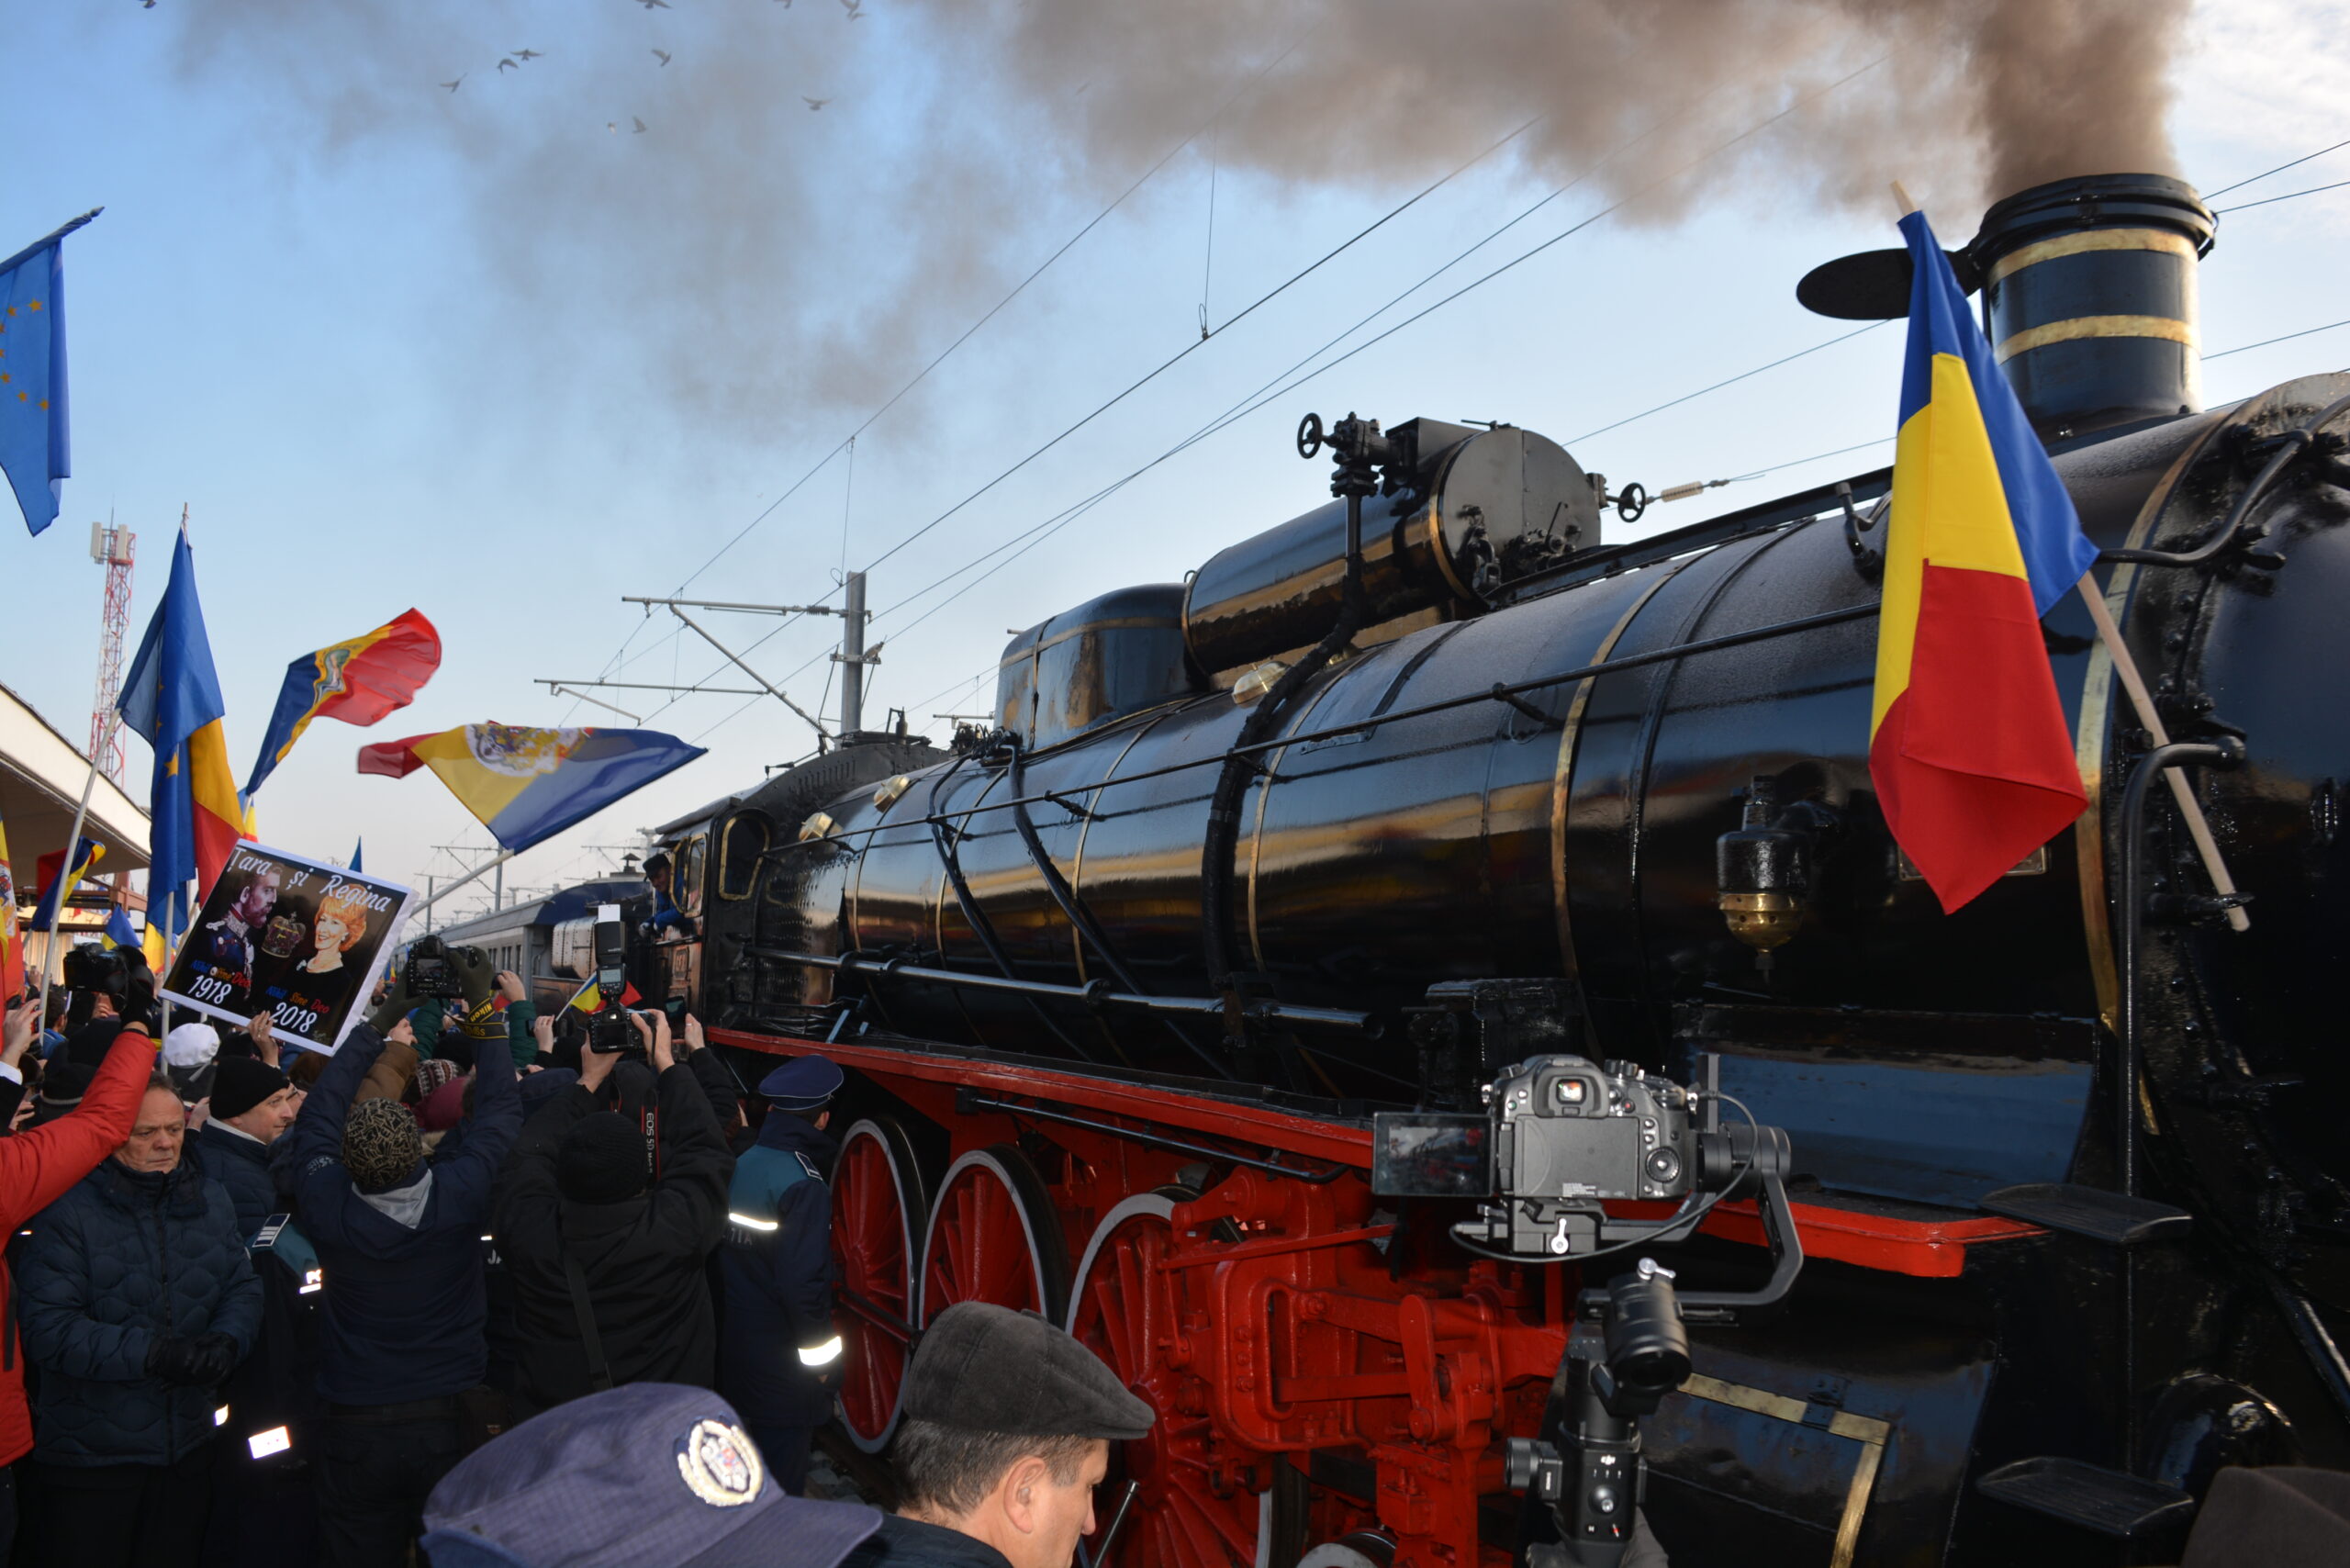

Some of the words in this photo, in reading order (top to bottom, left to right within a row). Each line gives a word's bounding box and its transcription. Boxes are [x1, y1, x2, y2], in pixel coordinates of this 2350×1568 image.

[319, 875, 392, 913] Regina
[187, 974, 232, 1004] 1918
[270, 1002, 318, 1033] 2018
[310, 999, 330, 1014] Deo
[470, 1002, 493, 1022] Nikon
[646, 1113, 655, 1137] EOS
[646, 1138, 655, 1150] 5D
